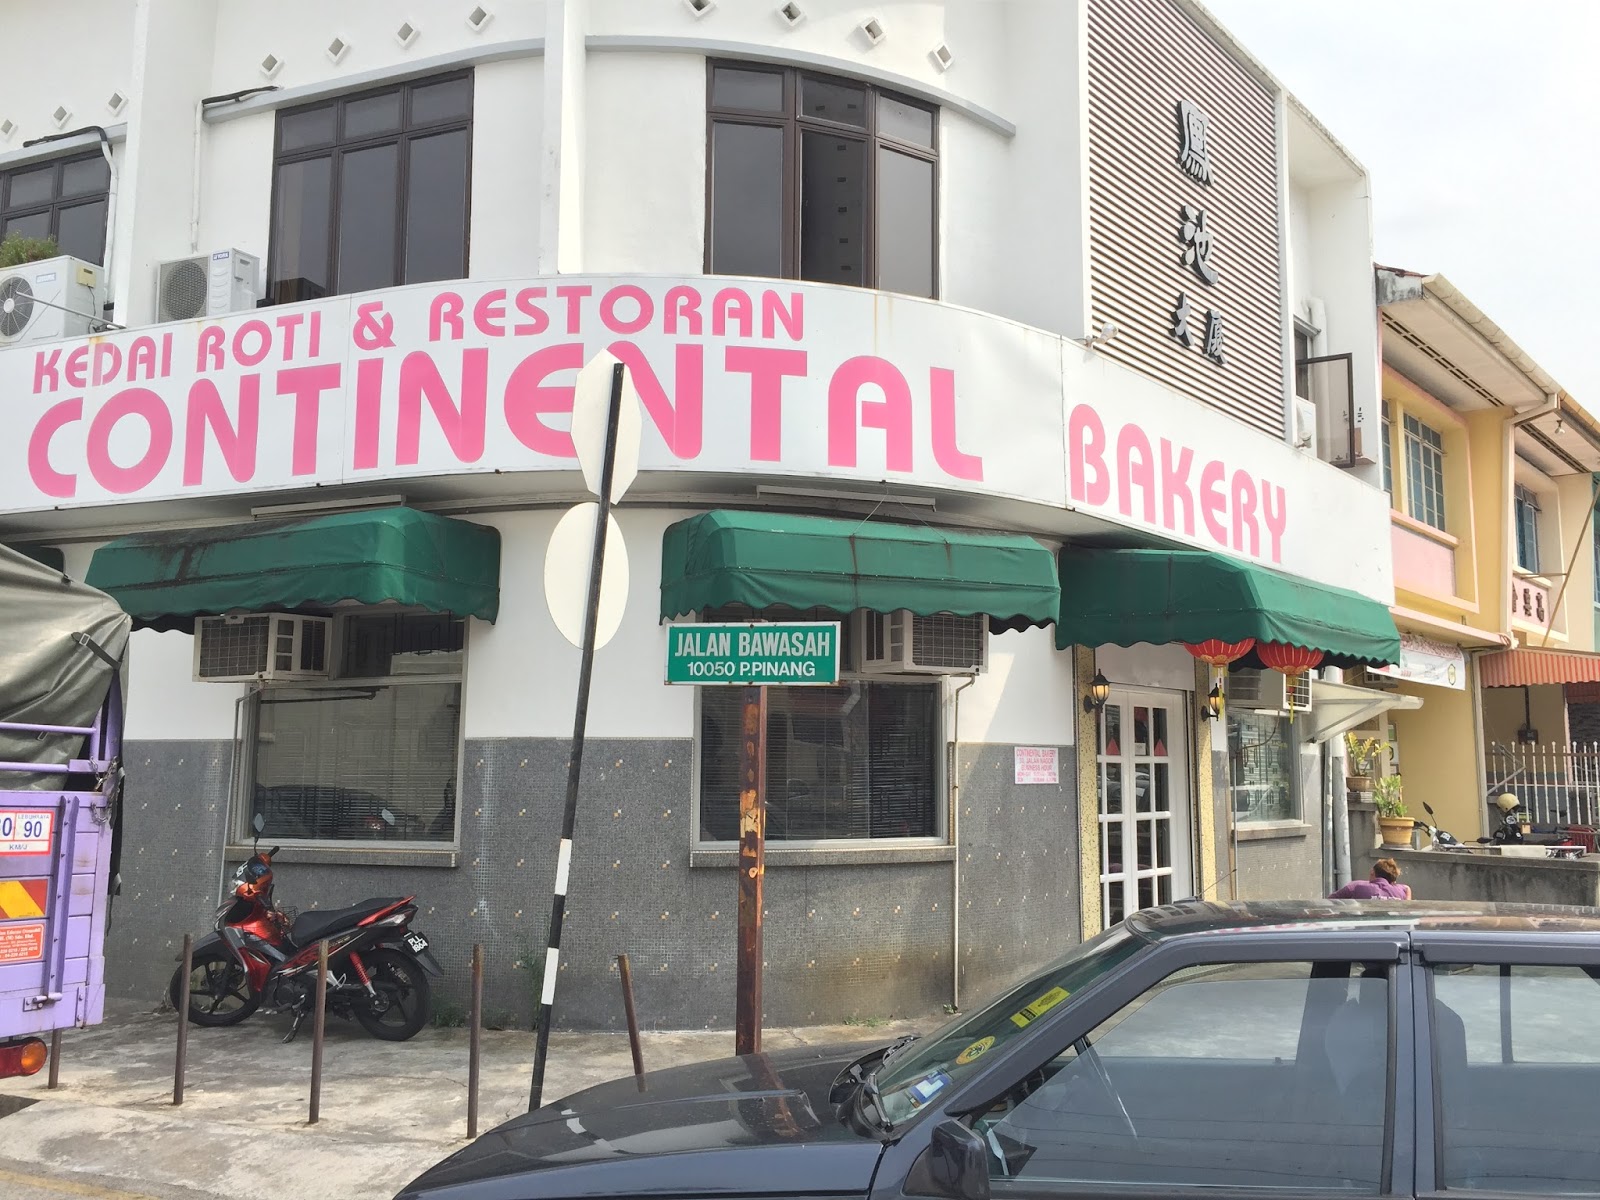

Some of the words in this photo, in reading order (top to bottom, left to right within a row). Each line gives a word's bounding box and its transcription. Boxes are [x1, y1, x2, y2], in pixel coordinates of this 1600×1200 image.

[33, 334, 172, 389] KEDAI
[197, 309, 321, 373] ROTI
[353, 302, 394, 350] &
[429, 285, 804, 342] RESTORAN
[28, 341, 983, 498] CONTINENTAL
[1069, 404, 1286, 563] BAKERY
[675, 633, 731, 657] JALAN
[738, 632, 830, 657] BAWASAH
[687, 661, 735, 676] 10050
[739, 661, 816, 677] P.PINANG
[0, 817, 13, 837] 0
[23, 820, 43, 838] 90
